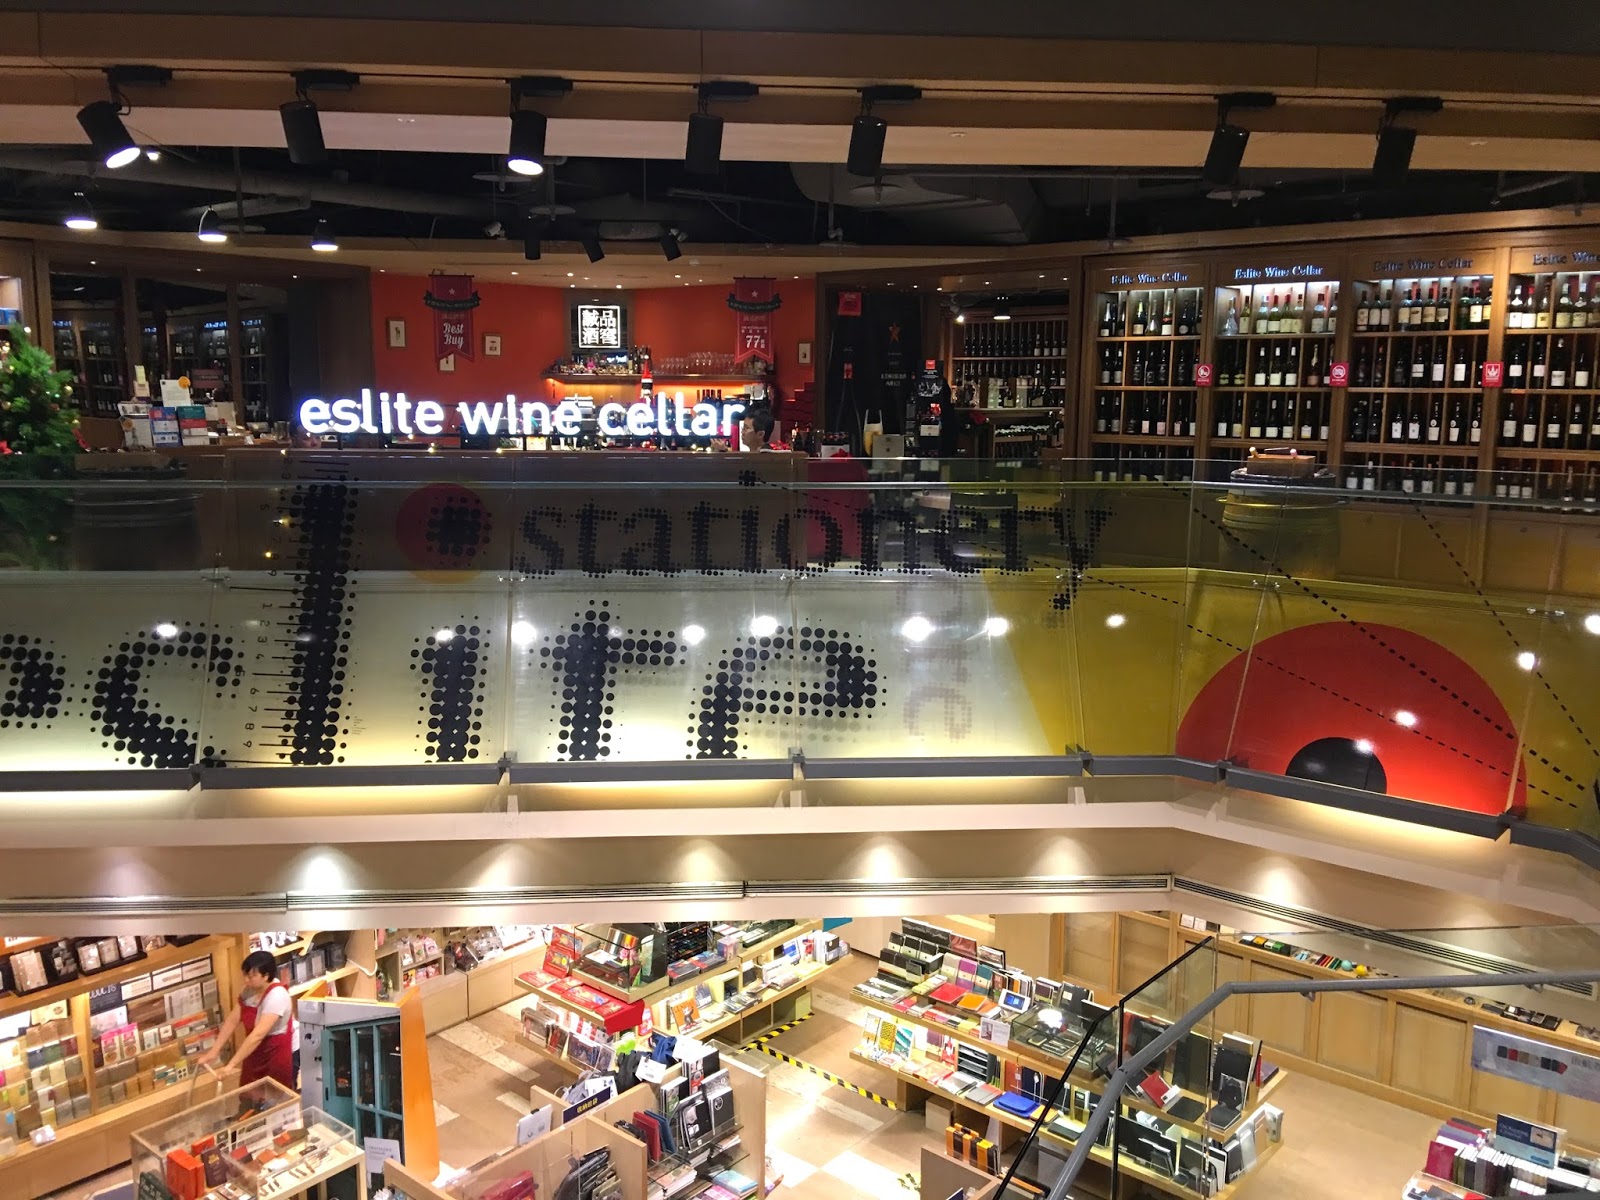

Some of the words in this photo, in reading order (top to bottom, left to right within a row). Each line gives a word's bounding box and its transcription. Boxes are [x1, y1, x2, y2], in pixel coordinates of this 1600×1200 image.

[1234, 267, 1262, 280] Eslite
[1265, 266, 1290, 278] Wine
[1292, 264, 1324, 276] Cellar
[1408, 258, 1435, 271] Wine
[1439, 257, 1473, 269] Cellar
[1138, 273, 1160, 284] Wine
[1161, 271, 1189, 282] Cellar
[443, 322, 464, 334] Best
[444, 333, 464, 349] Buy
[300, 388, 445, 434] eslite
[458, 394, 583, 436] wine
[599, 391, 745, 437] cellar
[516, 471, 1118, 612] stationery
